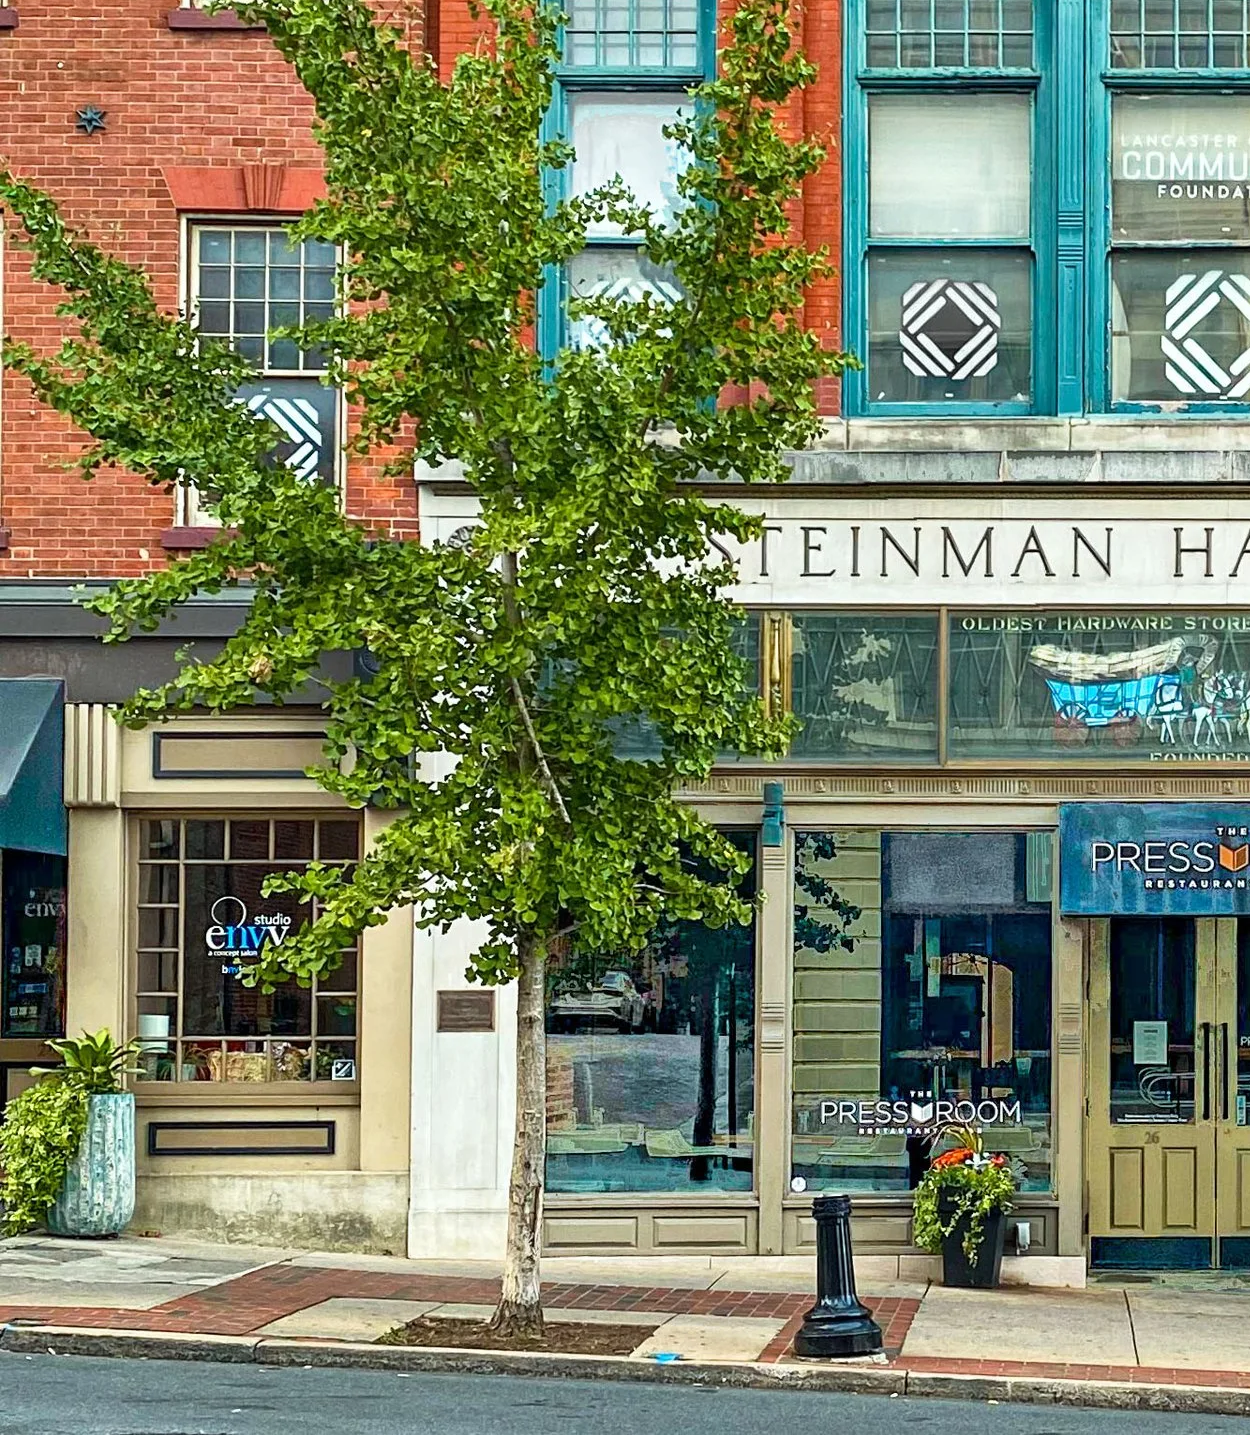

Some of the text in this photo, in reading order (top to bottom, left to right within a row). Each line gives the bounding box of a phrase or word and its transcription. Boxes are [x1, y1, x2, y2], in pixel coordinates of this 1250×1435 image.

[1120, 134, 1238, 148] LANCASTER
[962, 616, 1047, 631] OLDEST
[1057, 616, 1173, 631] HARDWARE
[1150, 752, 1249, 762] FOUNDED
[1216, 827, 1249, 836] THE
[1090, 842, 1214, 873] PRESS
[254, 912, 292, 926] studio
[909, 1090, 932, 1098] THE
[821, 1100, 1021, 1124] PRESS ROOM
[1144, 1132, 1160, 1144] 26
